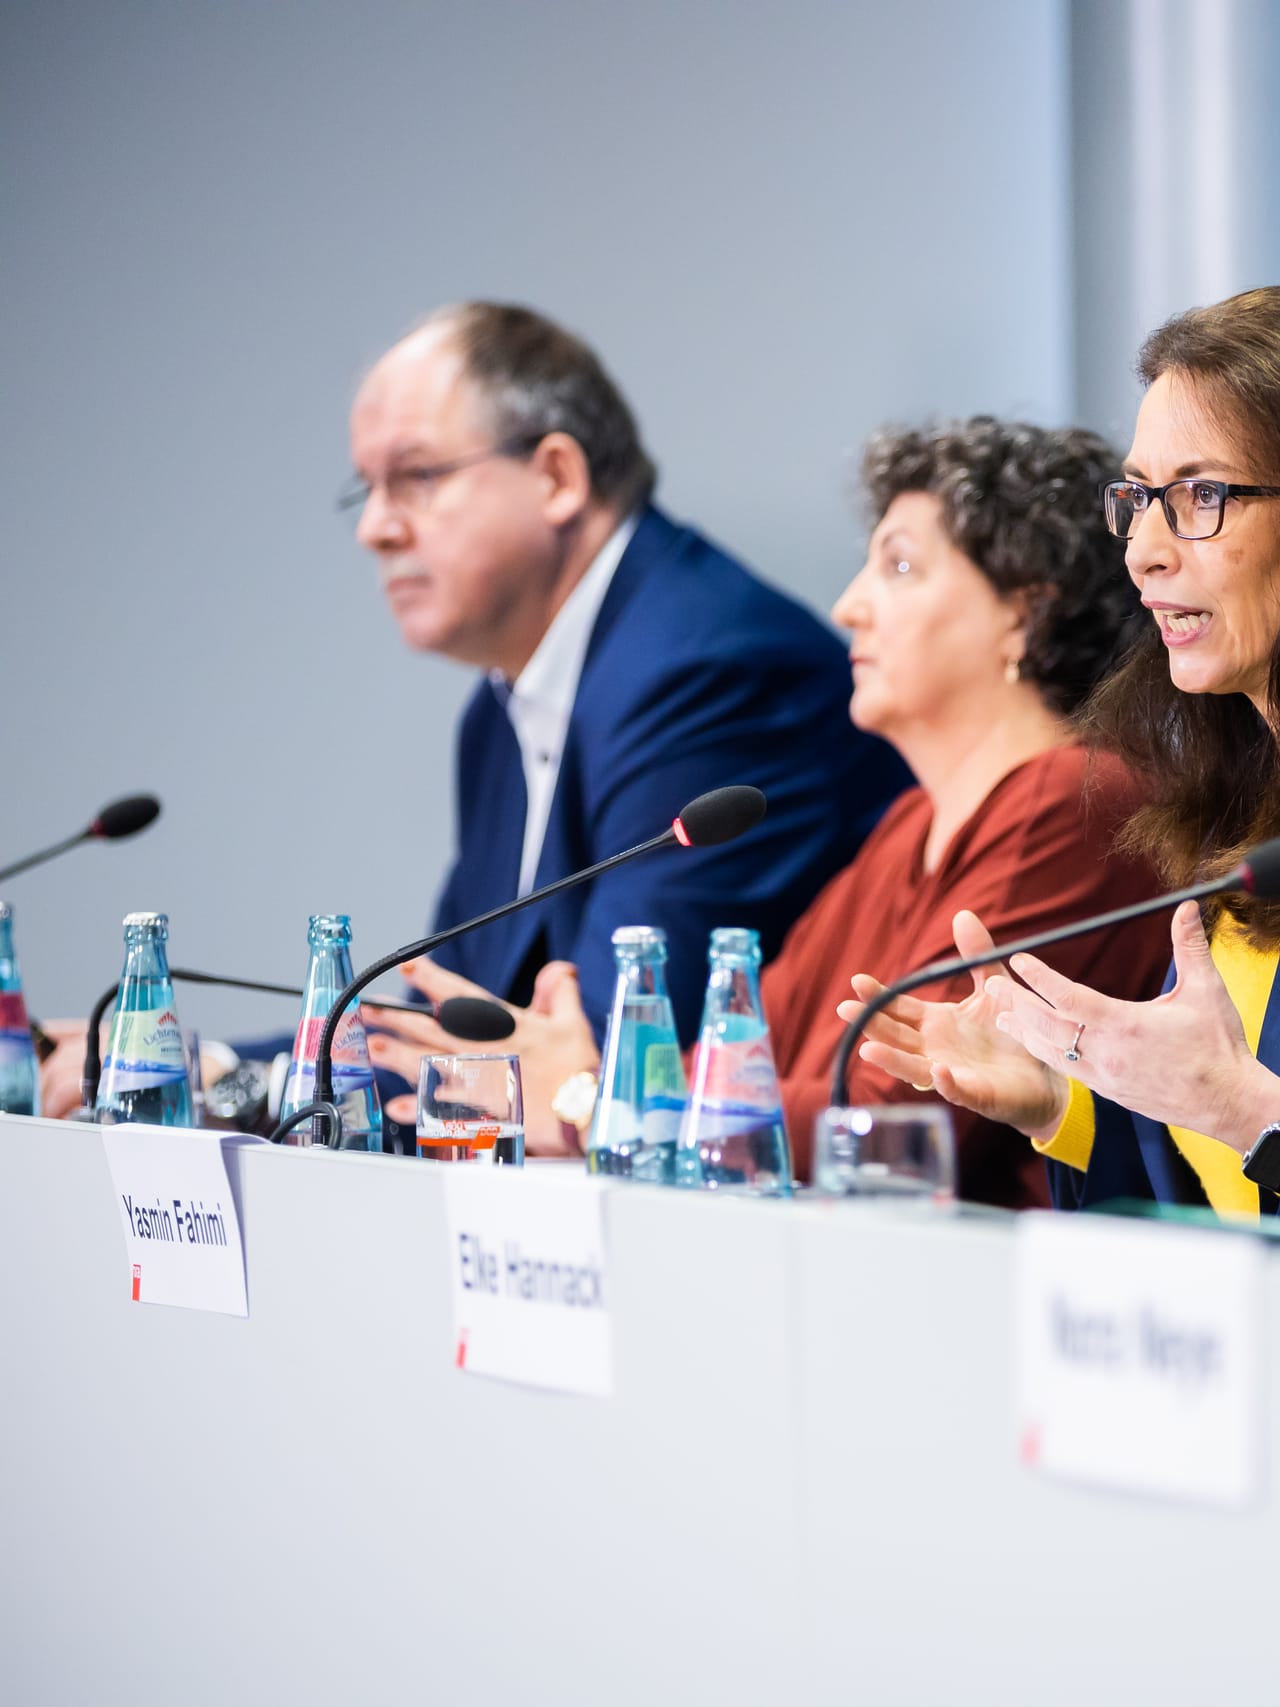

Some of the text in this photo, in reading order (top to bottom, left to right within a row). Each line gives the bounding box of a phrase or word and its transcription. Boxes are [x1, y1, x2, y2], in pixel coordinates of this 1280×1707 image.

[122, 1194, 227, 1247] Yasmin Fahimi
[458, 1231, 602, 1309] Elke Hannack
